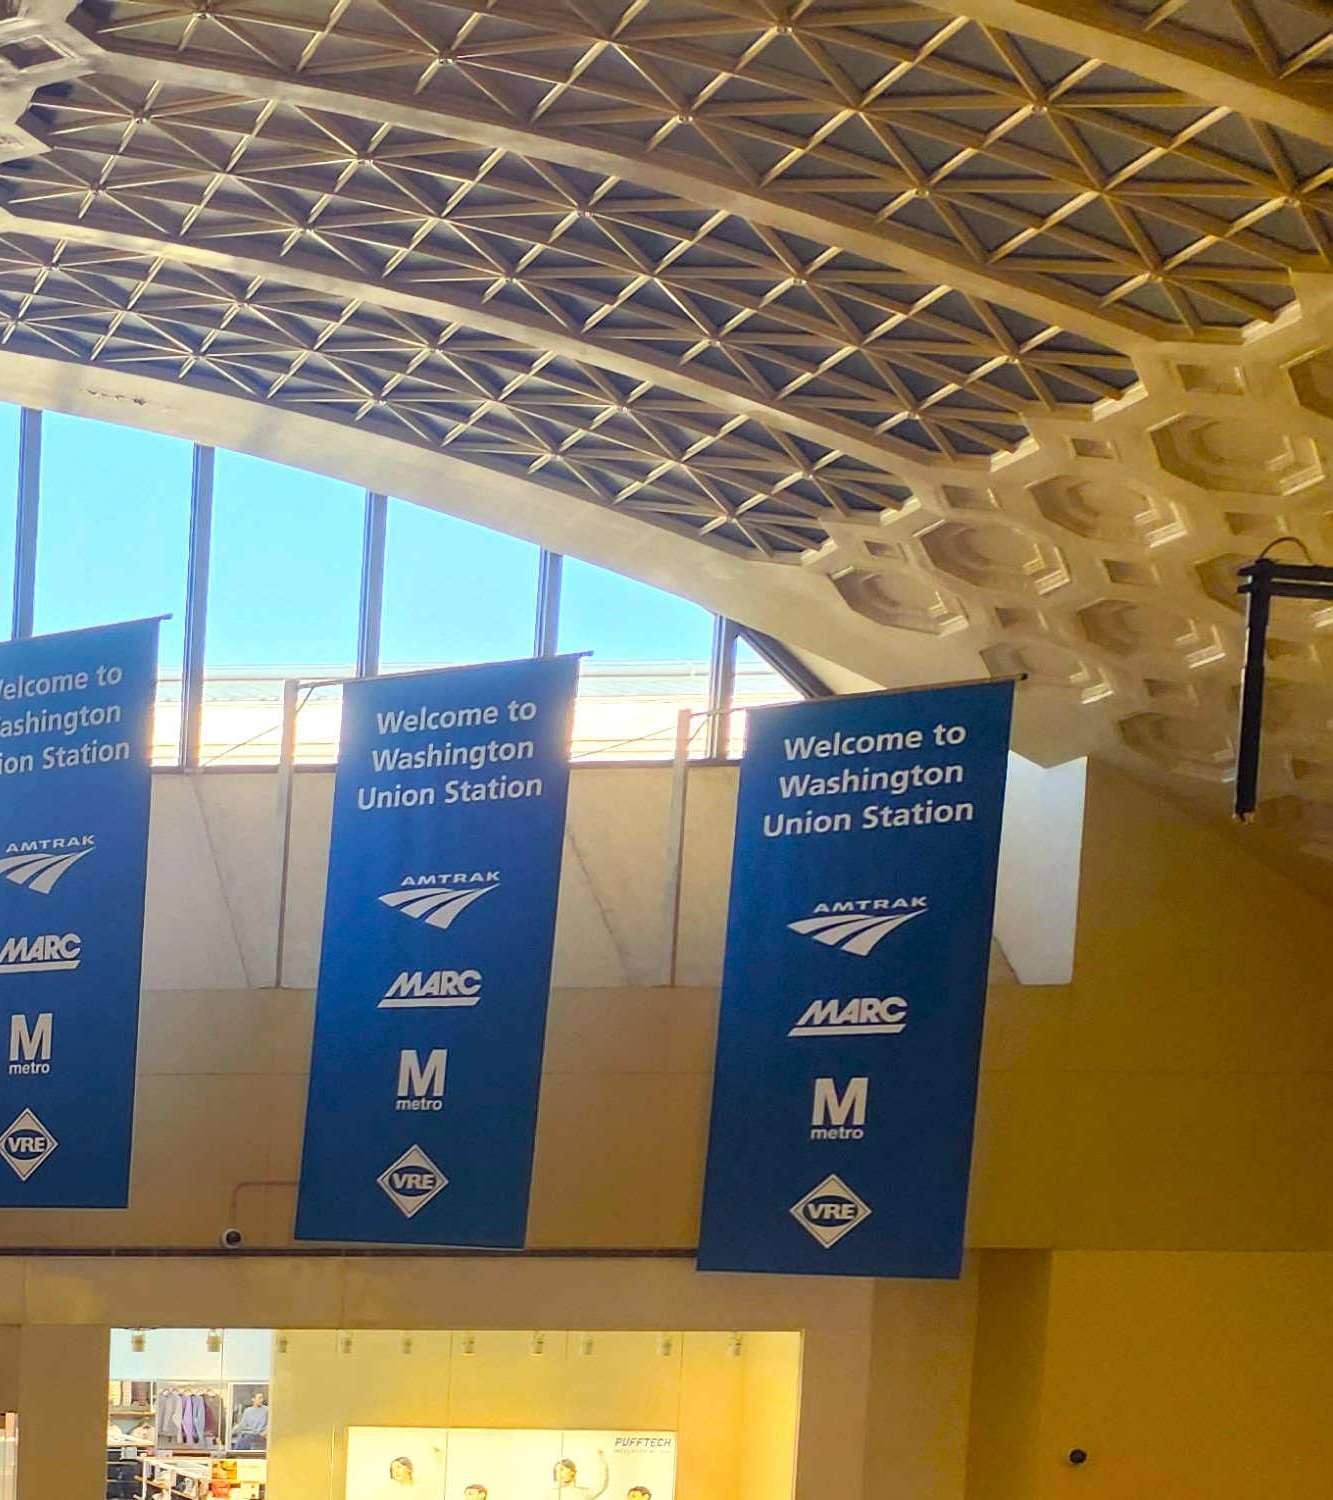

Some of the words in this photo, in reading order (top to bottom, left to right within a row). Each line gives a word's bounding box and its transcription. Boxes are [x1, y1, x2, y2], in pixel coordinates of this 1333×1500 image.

[96, 666, 122, 686] to
[376, 706, 498, 734] Welcome
[508, 700, 536, 721] to
[43, 738, 133, 769] Station
[372, 740, 533, 772] Washington
[784, 731, 922, 760] Welcome
[934, 724, 965, 745] to
[358, 784, 434, 809] Union
[445, 776, 542, 803] Station
[780, 765, 963, 798] Washington
[764, 811, 851, 836] Union
[863, 800, 973, 828] Station
[5, 835, 95, 853] AMTRAK
[400, 870, 501, 887] AMTRAK
[813, 896, 928, 914] AMTRAK
[385, 969, 482, 999] MARC
[796, 996, 907, 1026] MARC
[10, 1013, 52, 1061] M
[9, 1062, 49, 1074] metro
[398, 1050, 447, 1096] M
[397, 1098, 442, 1110] metro
[812, 1078, 868, 1125] M
[7, 1135, 47, 1154] VRE
[811, 1127, 863, 1139] metro
[393, 1171, 435, 1191] VRE
[803, 1201, 856, 1221] VRE
[614, 1437, 672, 1447] PUFFTECH
